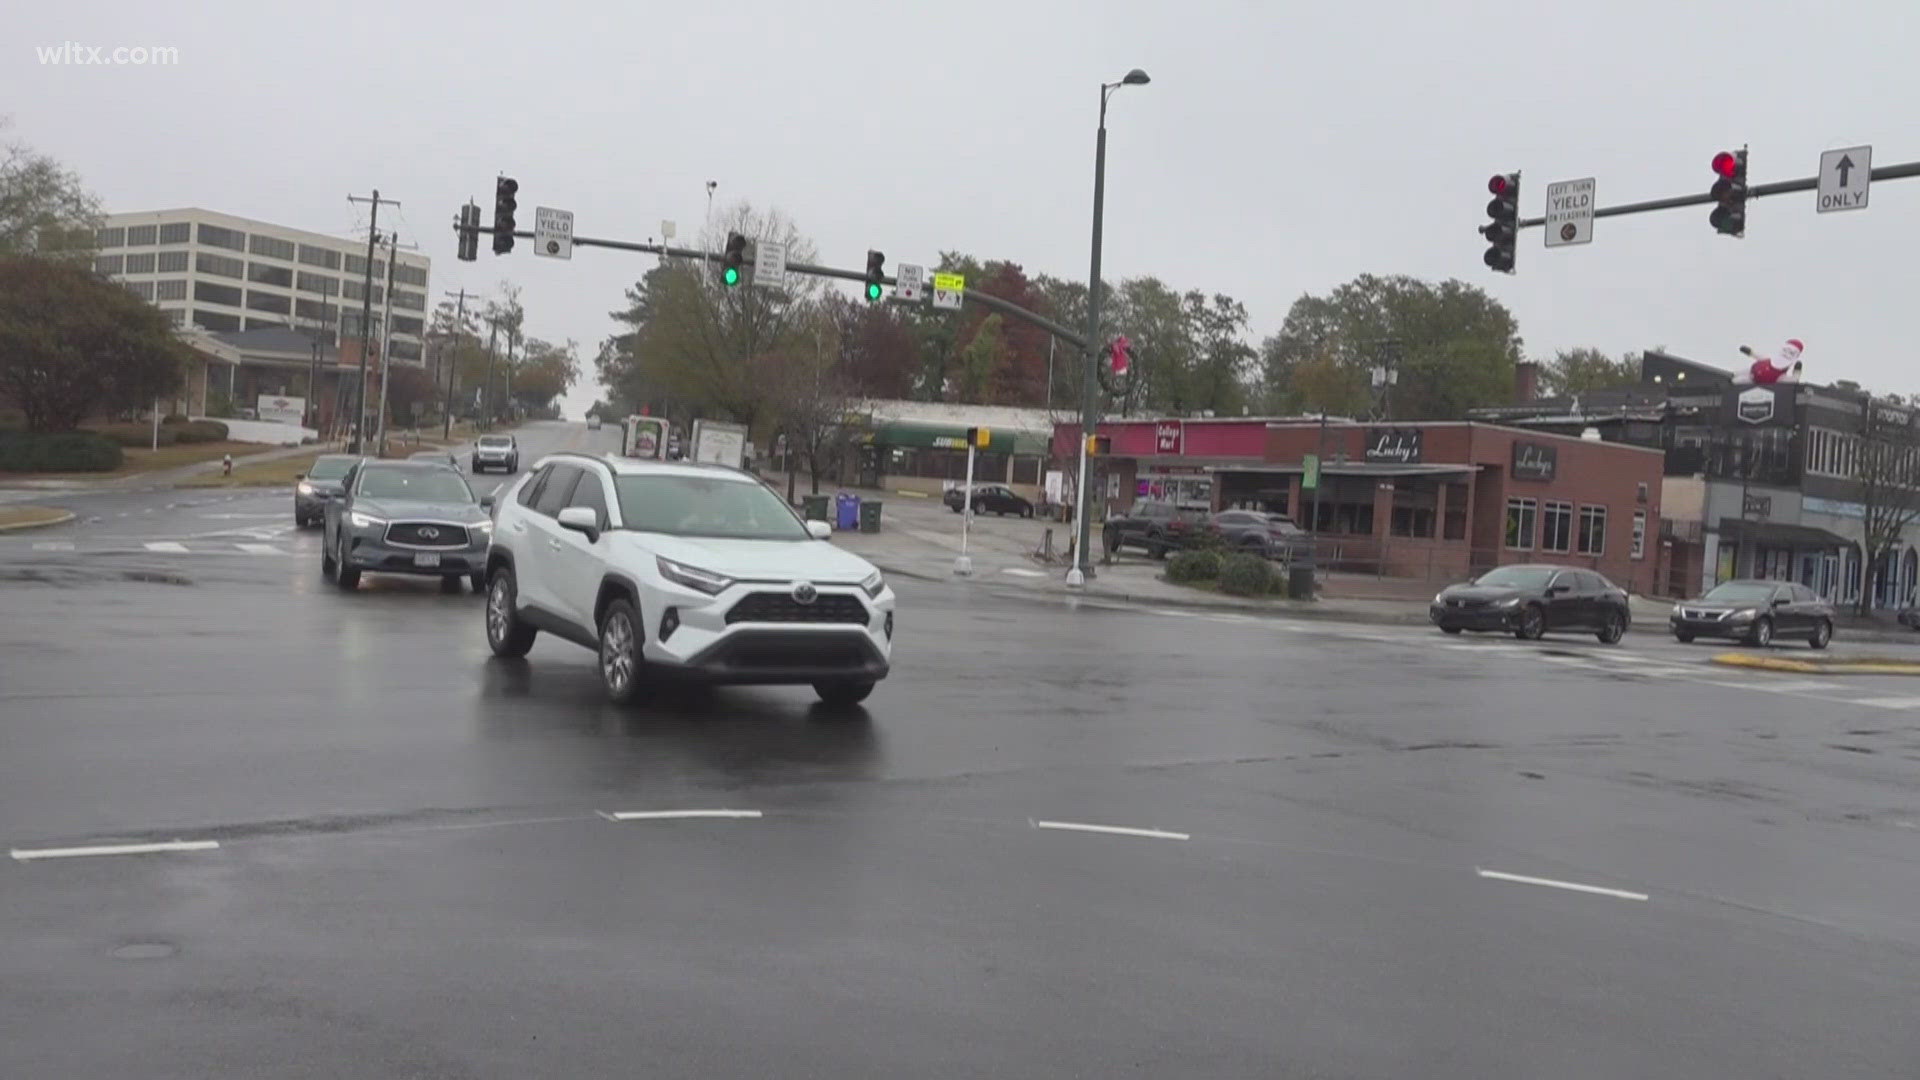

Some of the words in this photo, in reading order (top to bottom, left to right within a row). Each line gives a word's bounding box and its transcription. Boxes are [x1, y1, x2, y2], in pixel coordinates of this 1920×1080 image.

[1553, 194, 1589, 210] YIELD
[1821, 191, 1864, 208] ONLY
[541, 219, 569, 232] YIELD
[905, 267, 917, 275] NO
[932, 436, 968, 449] SUBWA
[1366, 434, 1418, 462] Lucky's
